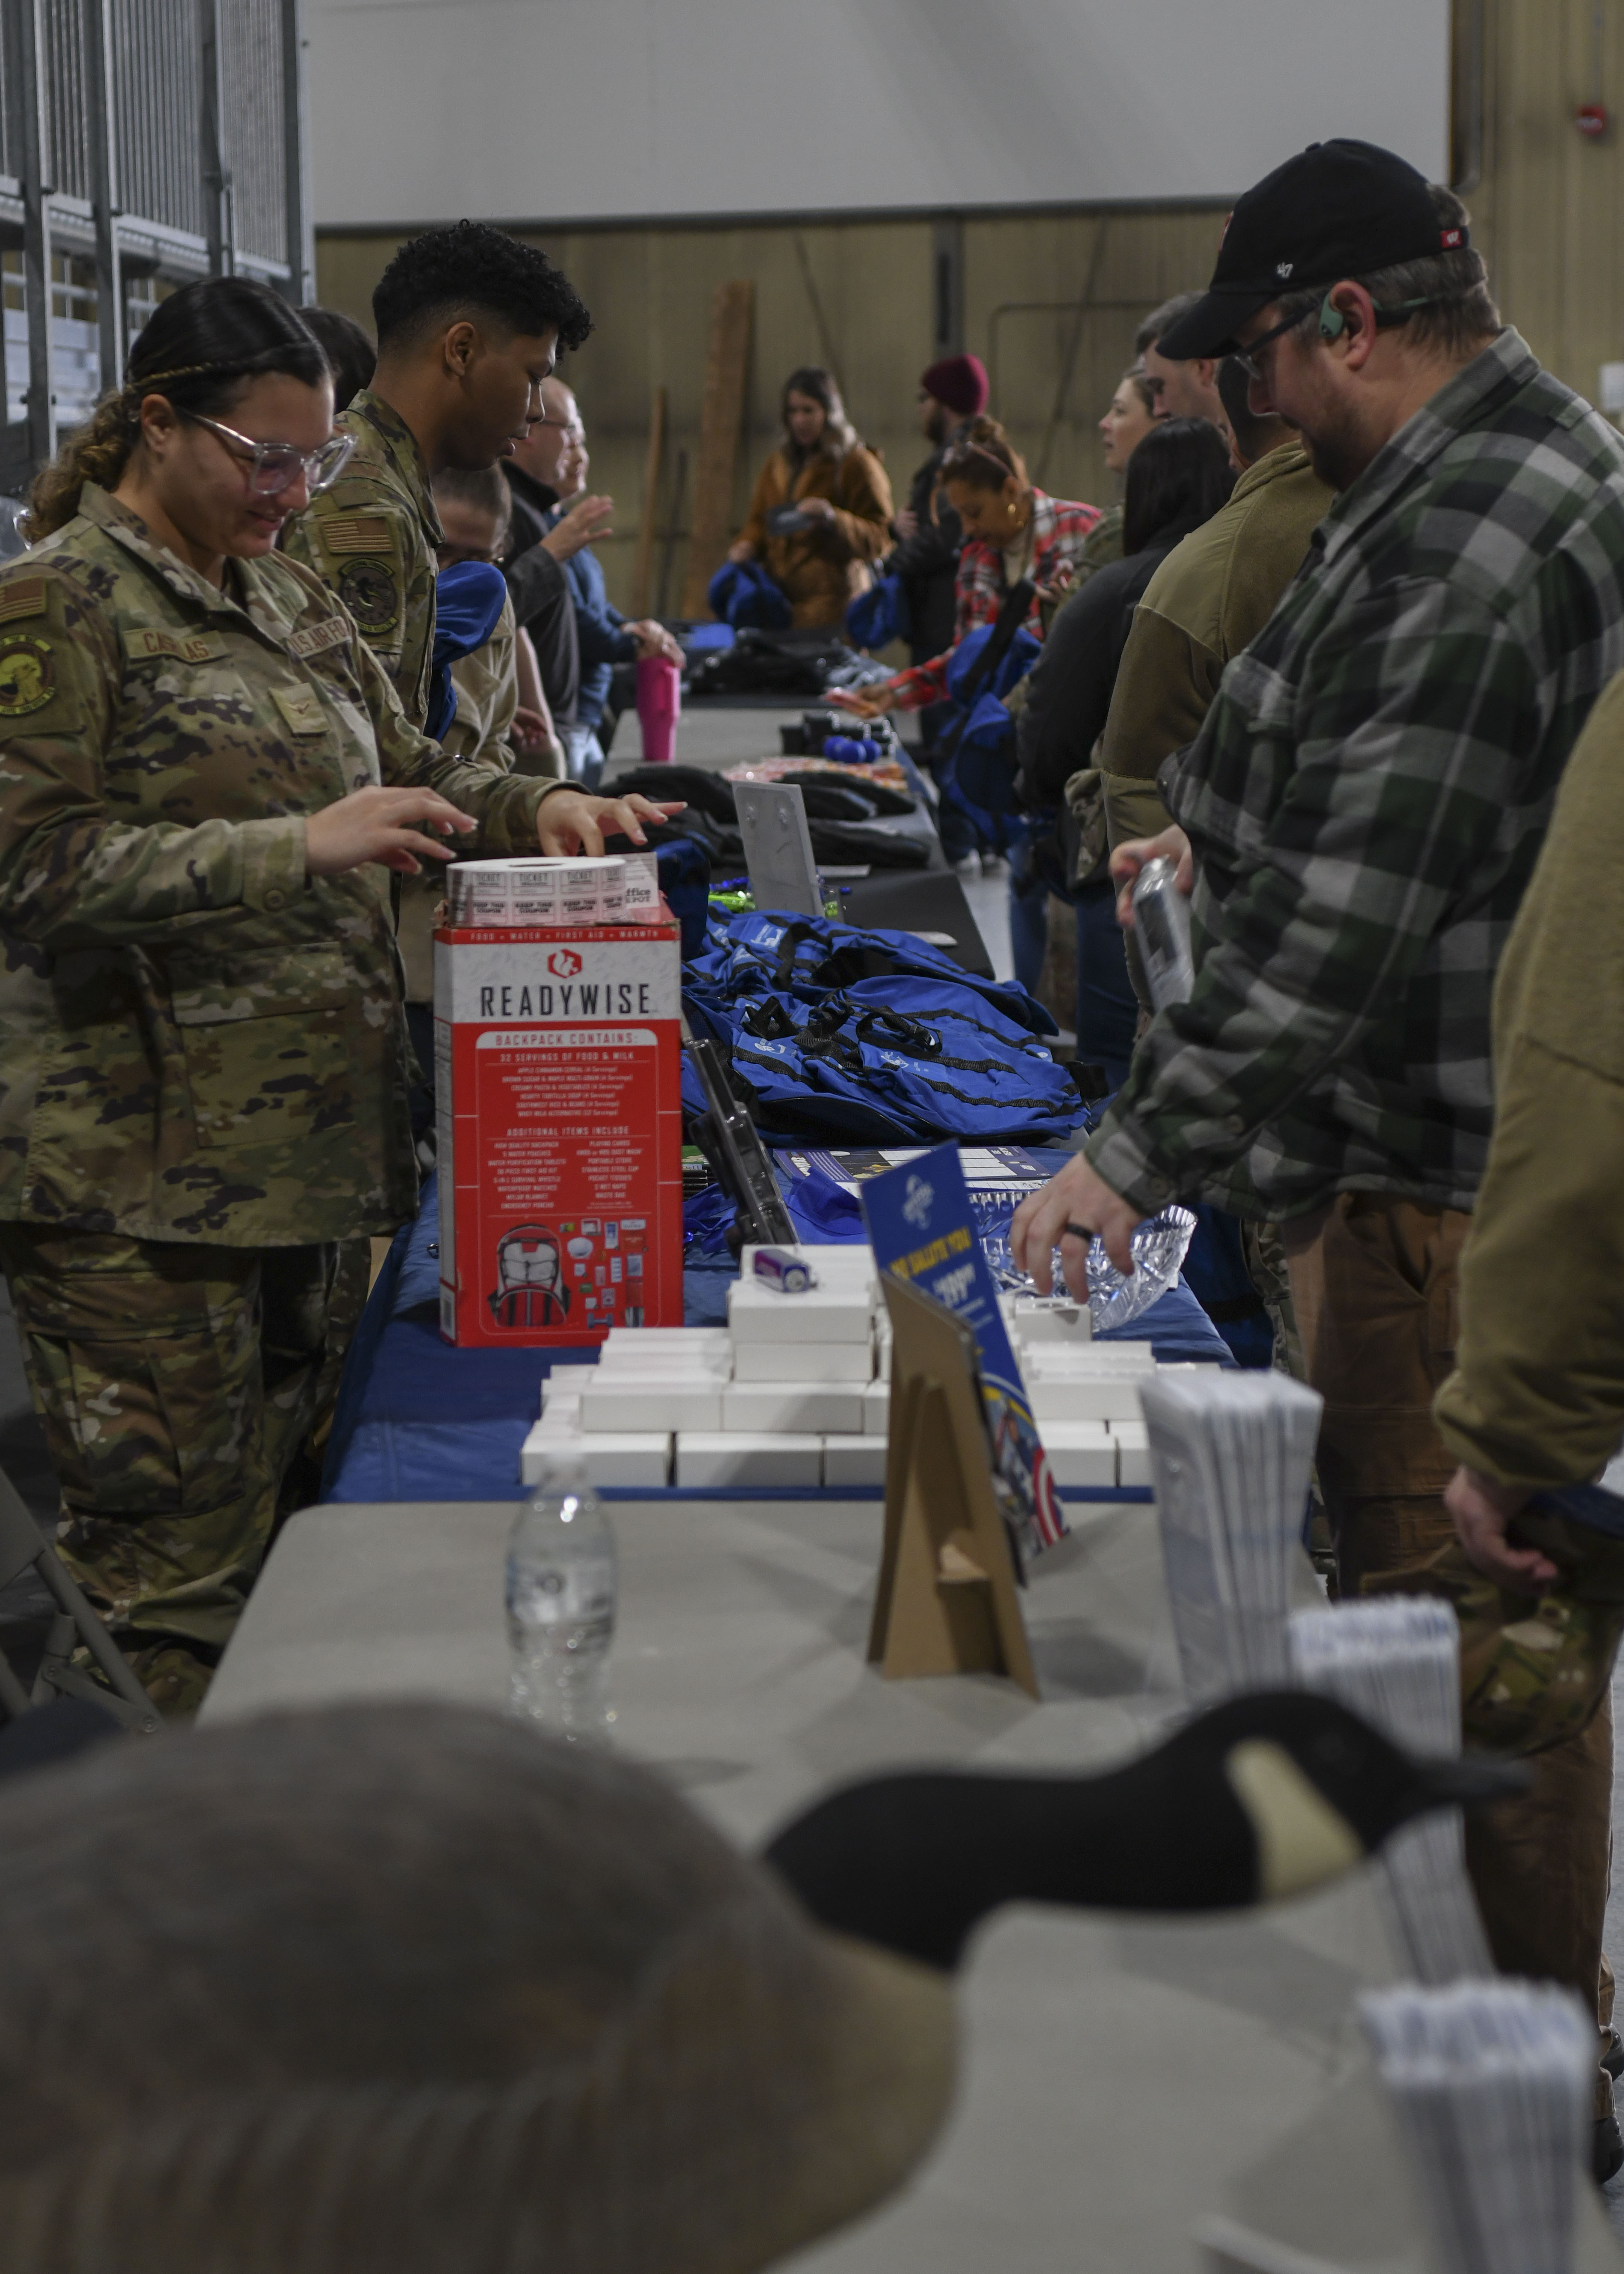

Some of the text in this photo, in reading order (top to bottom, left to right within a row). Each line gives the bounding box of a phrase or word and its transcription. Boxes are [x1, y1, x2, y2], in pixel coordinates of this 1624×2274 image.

[625, 887, 651, 897] ffice
[480, 983, 650, 1017] READYWISE
[495, 1034, 563, 1046] BACKPACK
[499, 1053, 512, 1062] 32
[515, 1053, 558, 1061] SERVINGS
[561, 1053, 572, 1061] OF
[576, 1052, 599, 1061] FOOD
[612, 1051, 634, 1060] MILK
[506, 1126, 629, 1136] ADDITIONAL ITEMS INCLUDE
